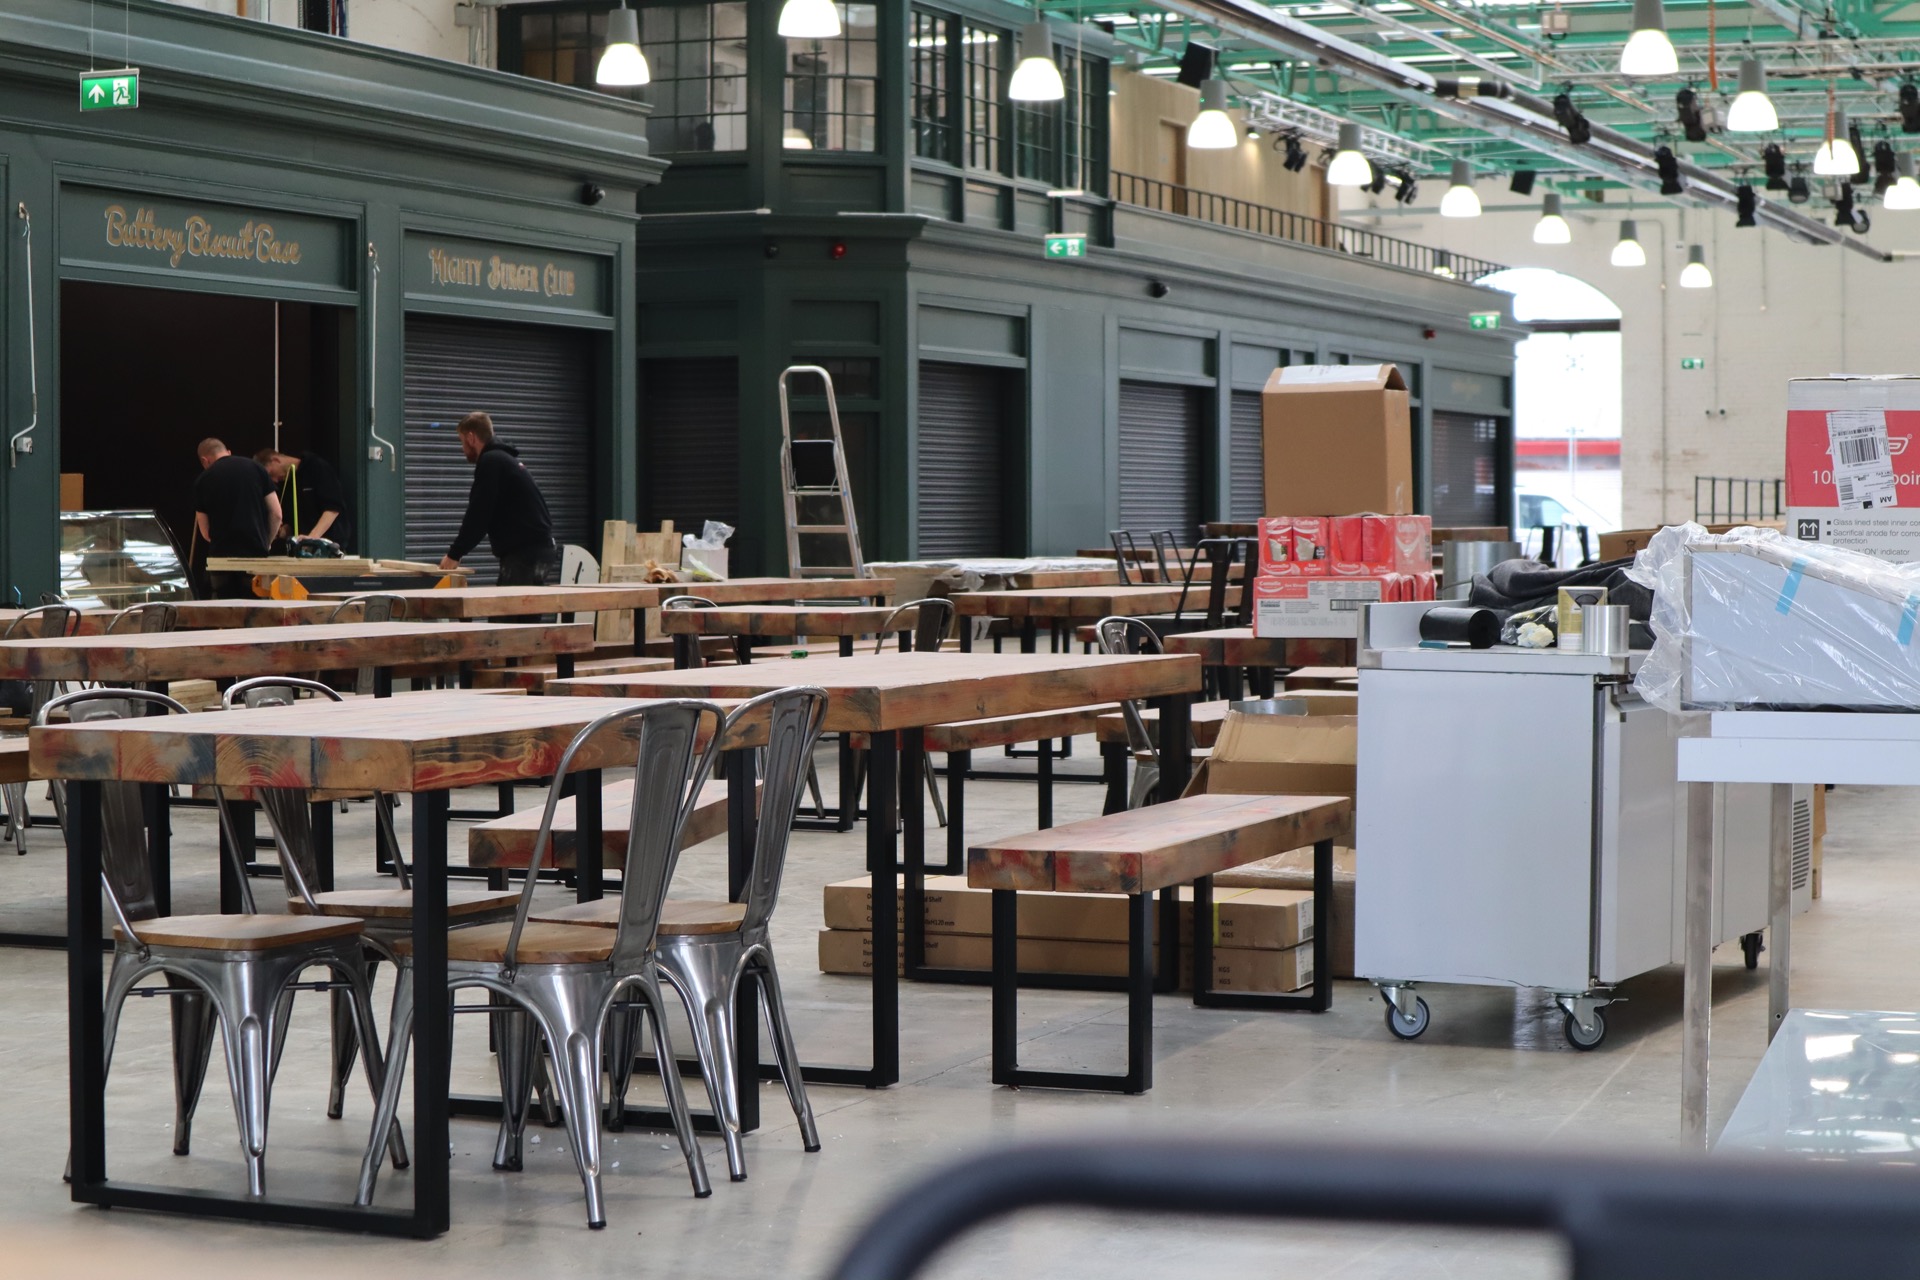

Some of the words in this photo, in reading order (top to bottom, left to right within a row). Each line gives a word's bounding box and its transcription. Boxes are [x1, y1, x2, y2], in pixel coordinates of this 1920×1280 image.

[104, 205, 186, 268] Buttery
[185, 215, 254, 260] Biscuit
[254, 223, 301, 264] Base
[429, 248, 483, 286] MIGHTY
[487, 255, 540, 292] BURGER
[544, 263, 576, 297] CLUB
[1833, 518, 1853, 526] Glass
[1890, 519, 1908, 527] inner
[1865, 529, 1888, 537] anode
[1889, 529, 1899, 537] for
[1832, 537, 1868, 545] protection
[1881, 547, 1910, 556] indicator
